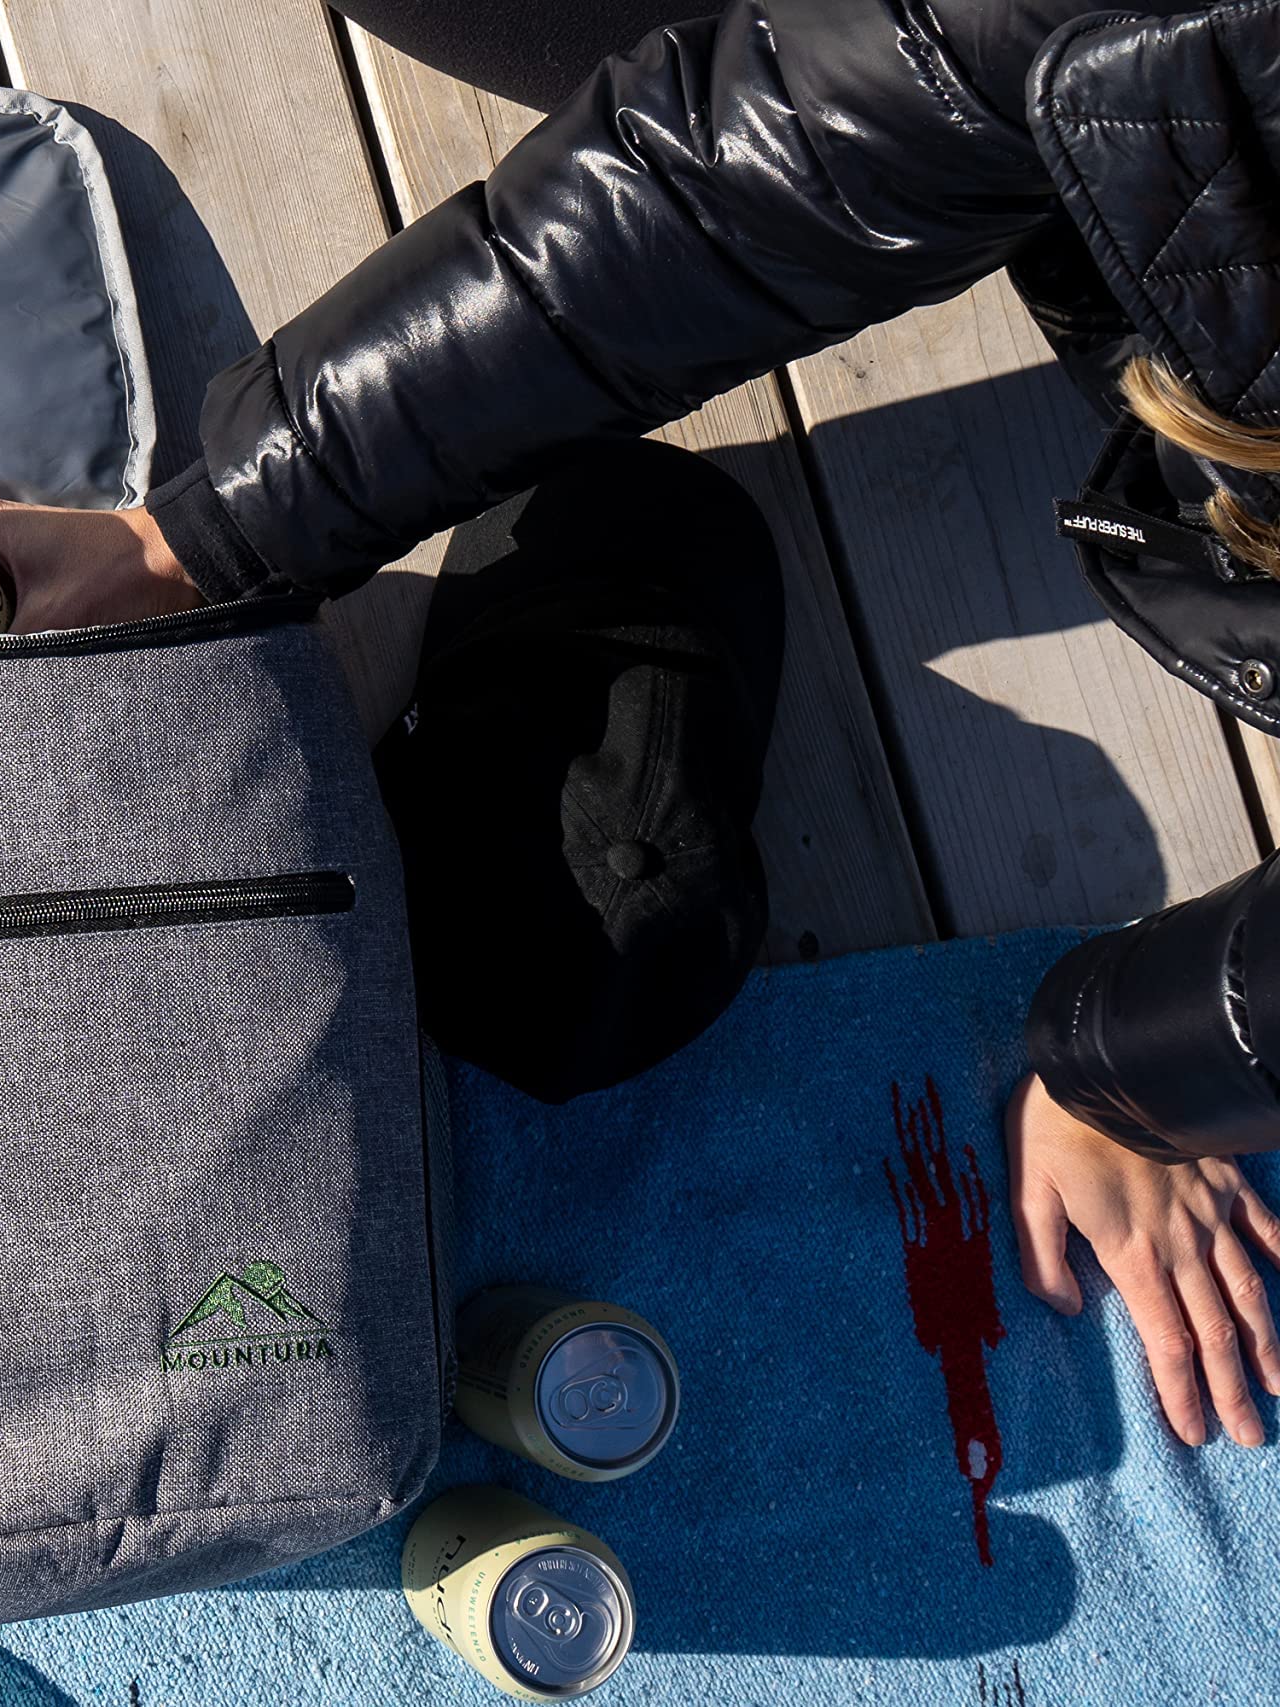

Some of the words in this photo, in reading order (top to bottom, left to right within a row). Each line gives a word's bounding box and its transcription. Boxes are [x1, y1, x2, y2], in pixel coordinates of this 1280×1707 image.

[1098, 519, 1127, 538] SUPER
[1127, 526, 1146, 543] THE
[160, 1338, 332, 1373] MOUNTURA
[468, 1571, 487, 1662] UNSWEETENED
